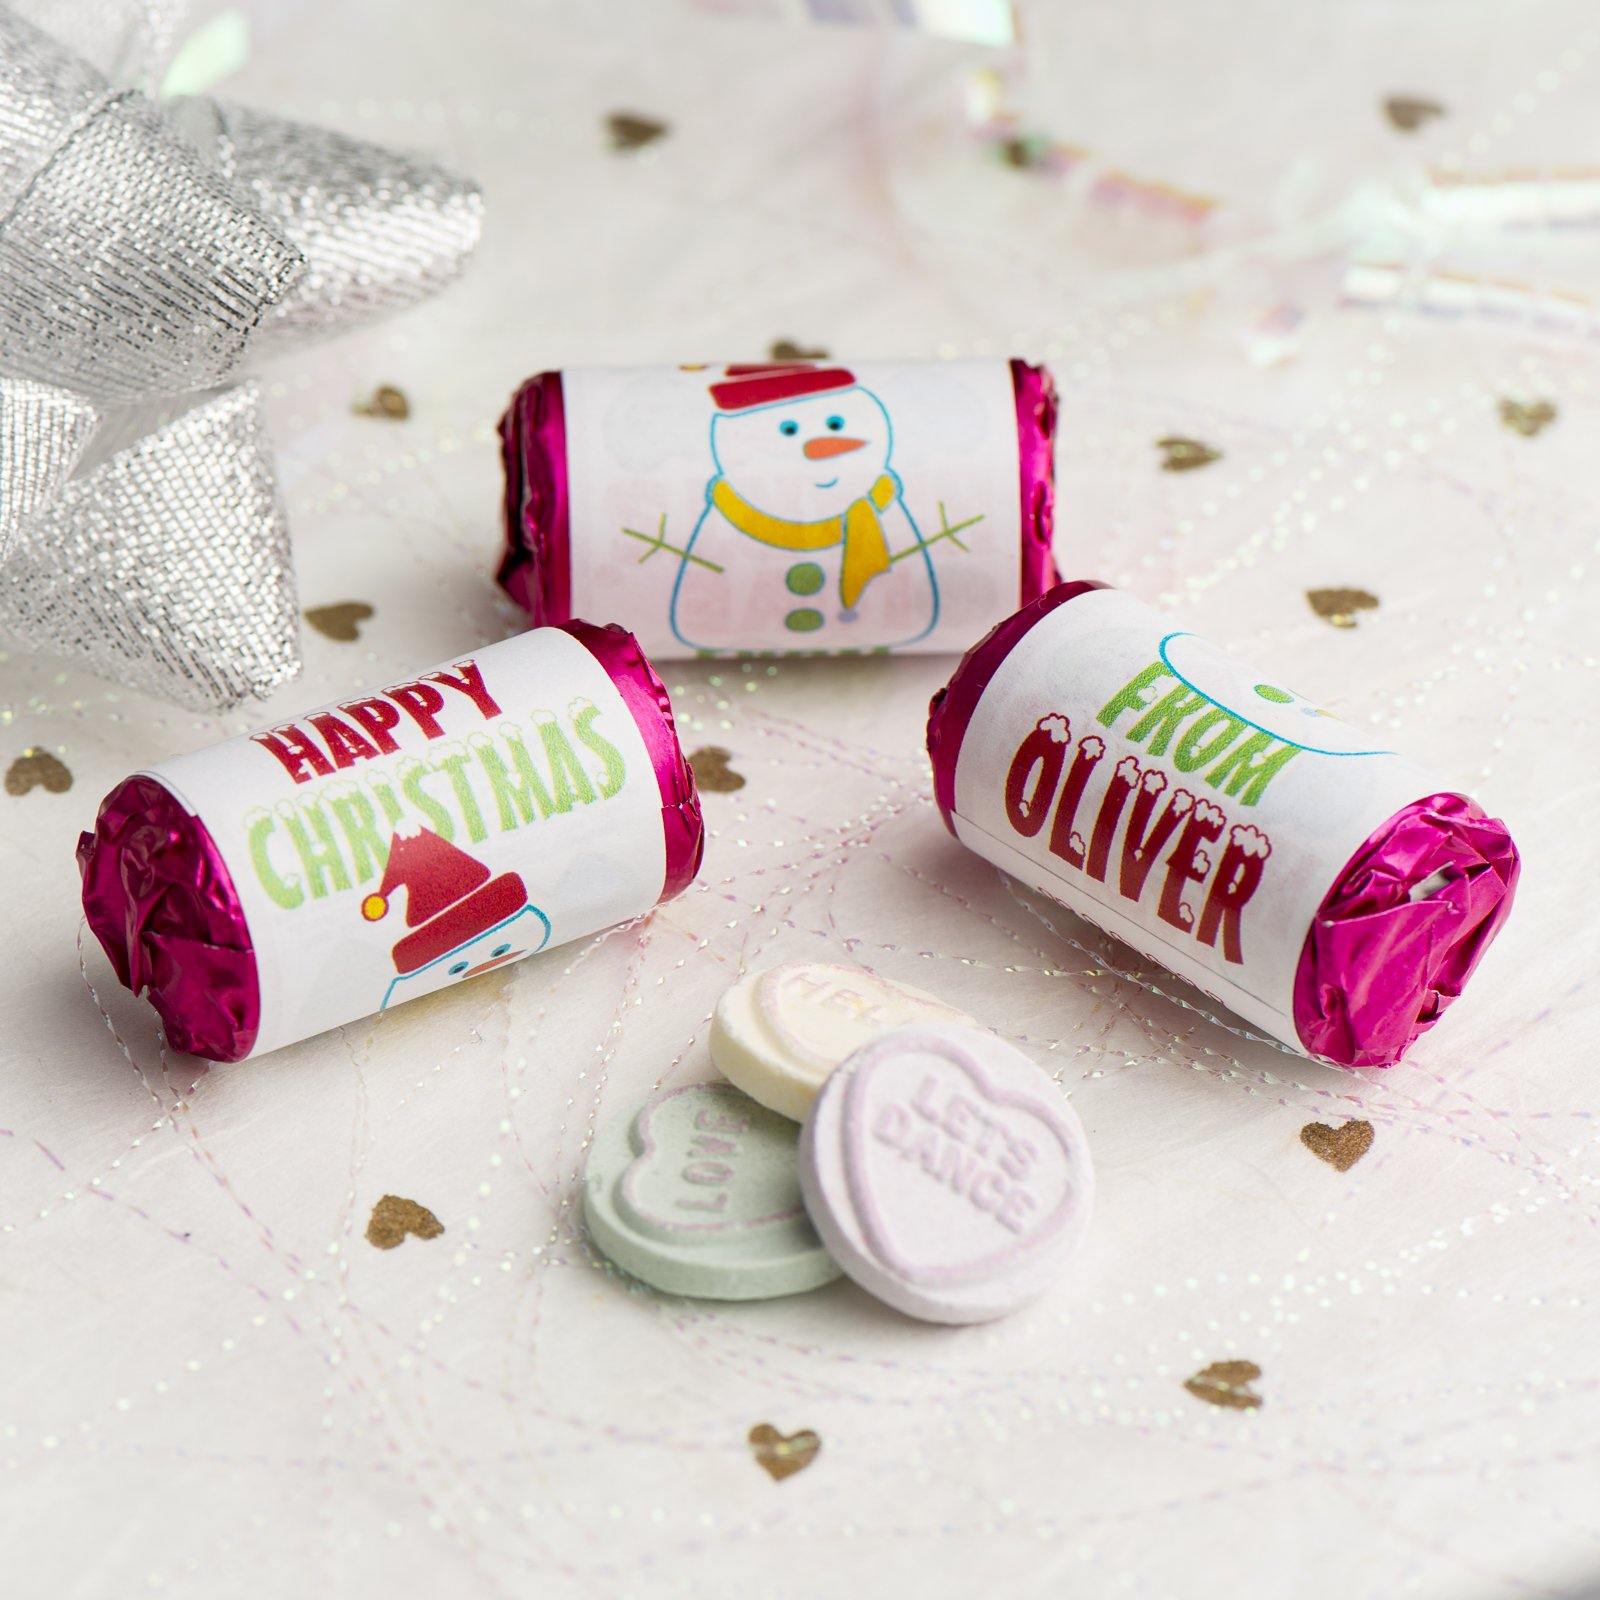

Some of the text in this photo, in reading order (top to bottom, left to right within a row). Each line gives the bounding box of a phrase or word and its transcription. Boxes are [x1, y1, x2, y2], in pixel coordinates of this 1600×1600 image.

[251, 659, 503, 785] HAPPY
[1096, 661, 1302, 806] FROM
[1004, 712, 1272, 965] OLIVER
[675, 1107, 749, 1212] LOVE
[872, 1103, 1037, 1235] DANCE
